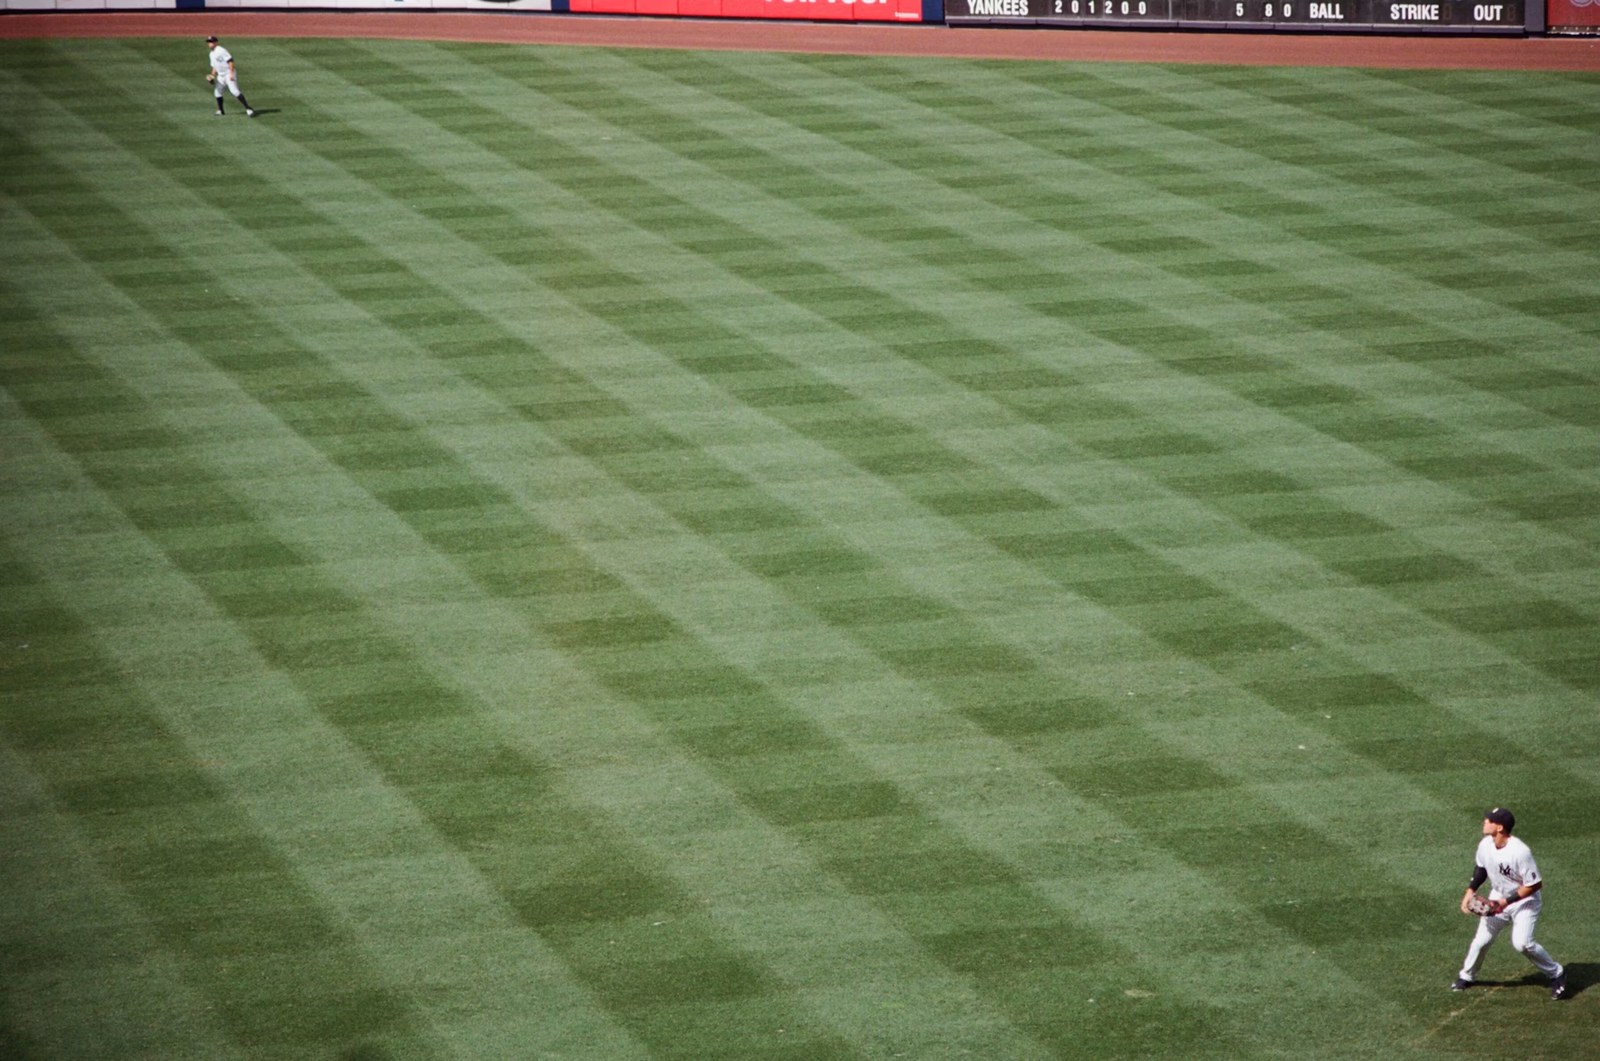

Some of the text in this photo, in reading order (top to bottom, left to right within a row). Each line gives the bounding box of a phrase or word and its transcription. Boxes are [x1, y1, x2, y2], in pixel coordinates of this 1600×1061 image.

[967, 0, 1292, 17] YANKEES 2 0 1 2 0 0 5 8 0
[1309, 3, 1344, 19] BALL
[1390, 4, 1440, 20] STRIKE
[1473, 5, 1503, 21] OUT
